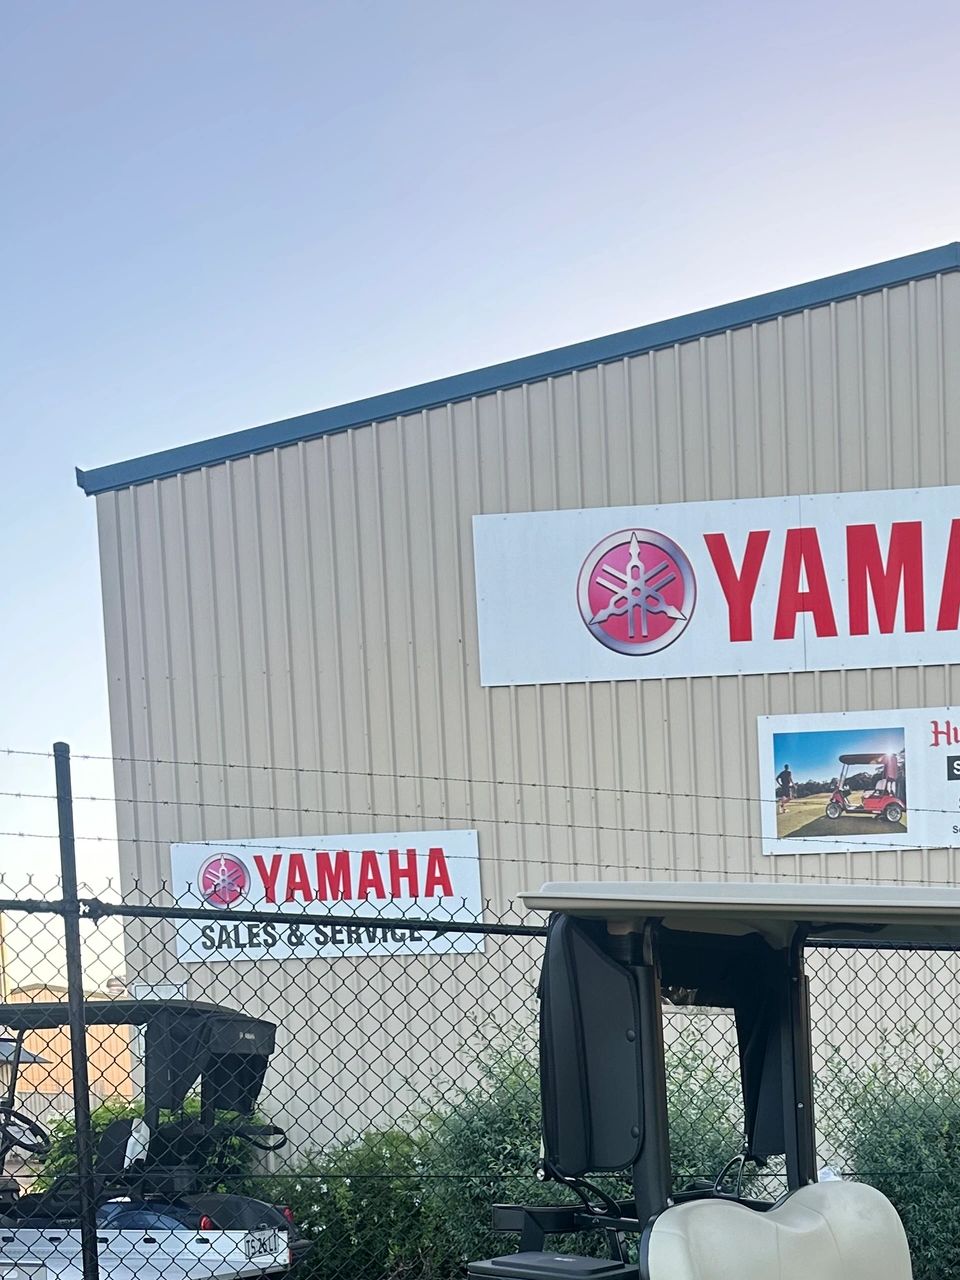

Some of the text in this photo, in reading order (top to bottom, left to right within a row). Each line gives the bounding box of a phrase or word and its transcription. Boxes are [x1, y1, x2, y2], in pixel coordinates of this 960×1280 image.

[253, 847, 454, 904] YAMAHA
[201, 922, 277, 950] SALES
[287, 921, 304, 946] &
